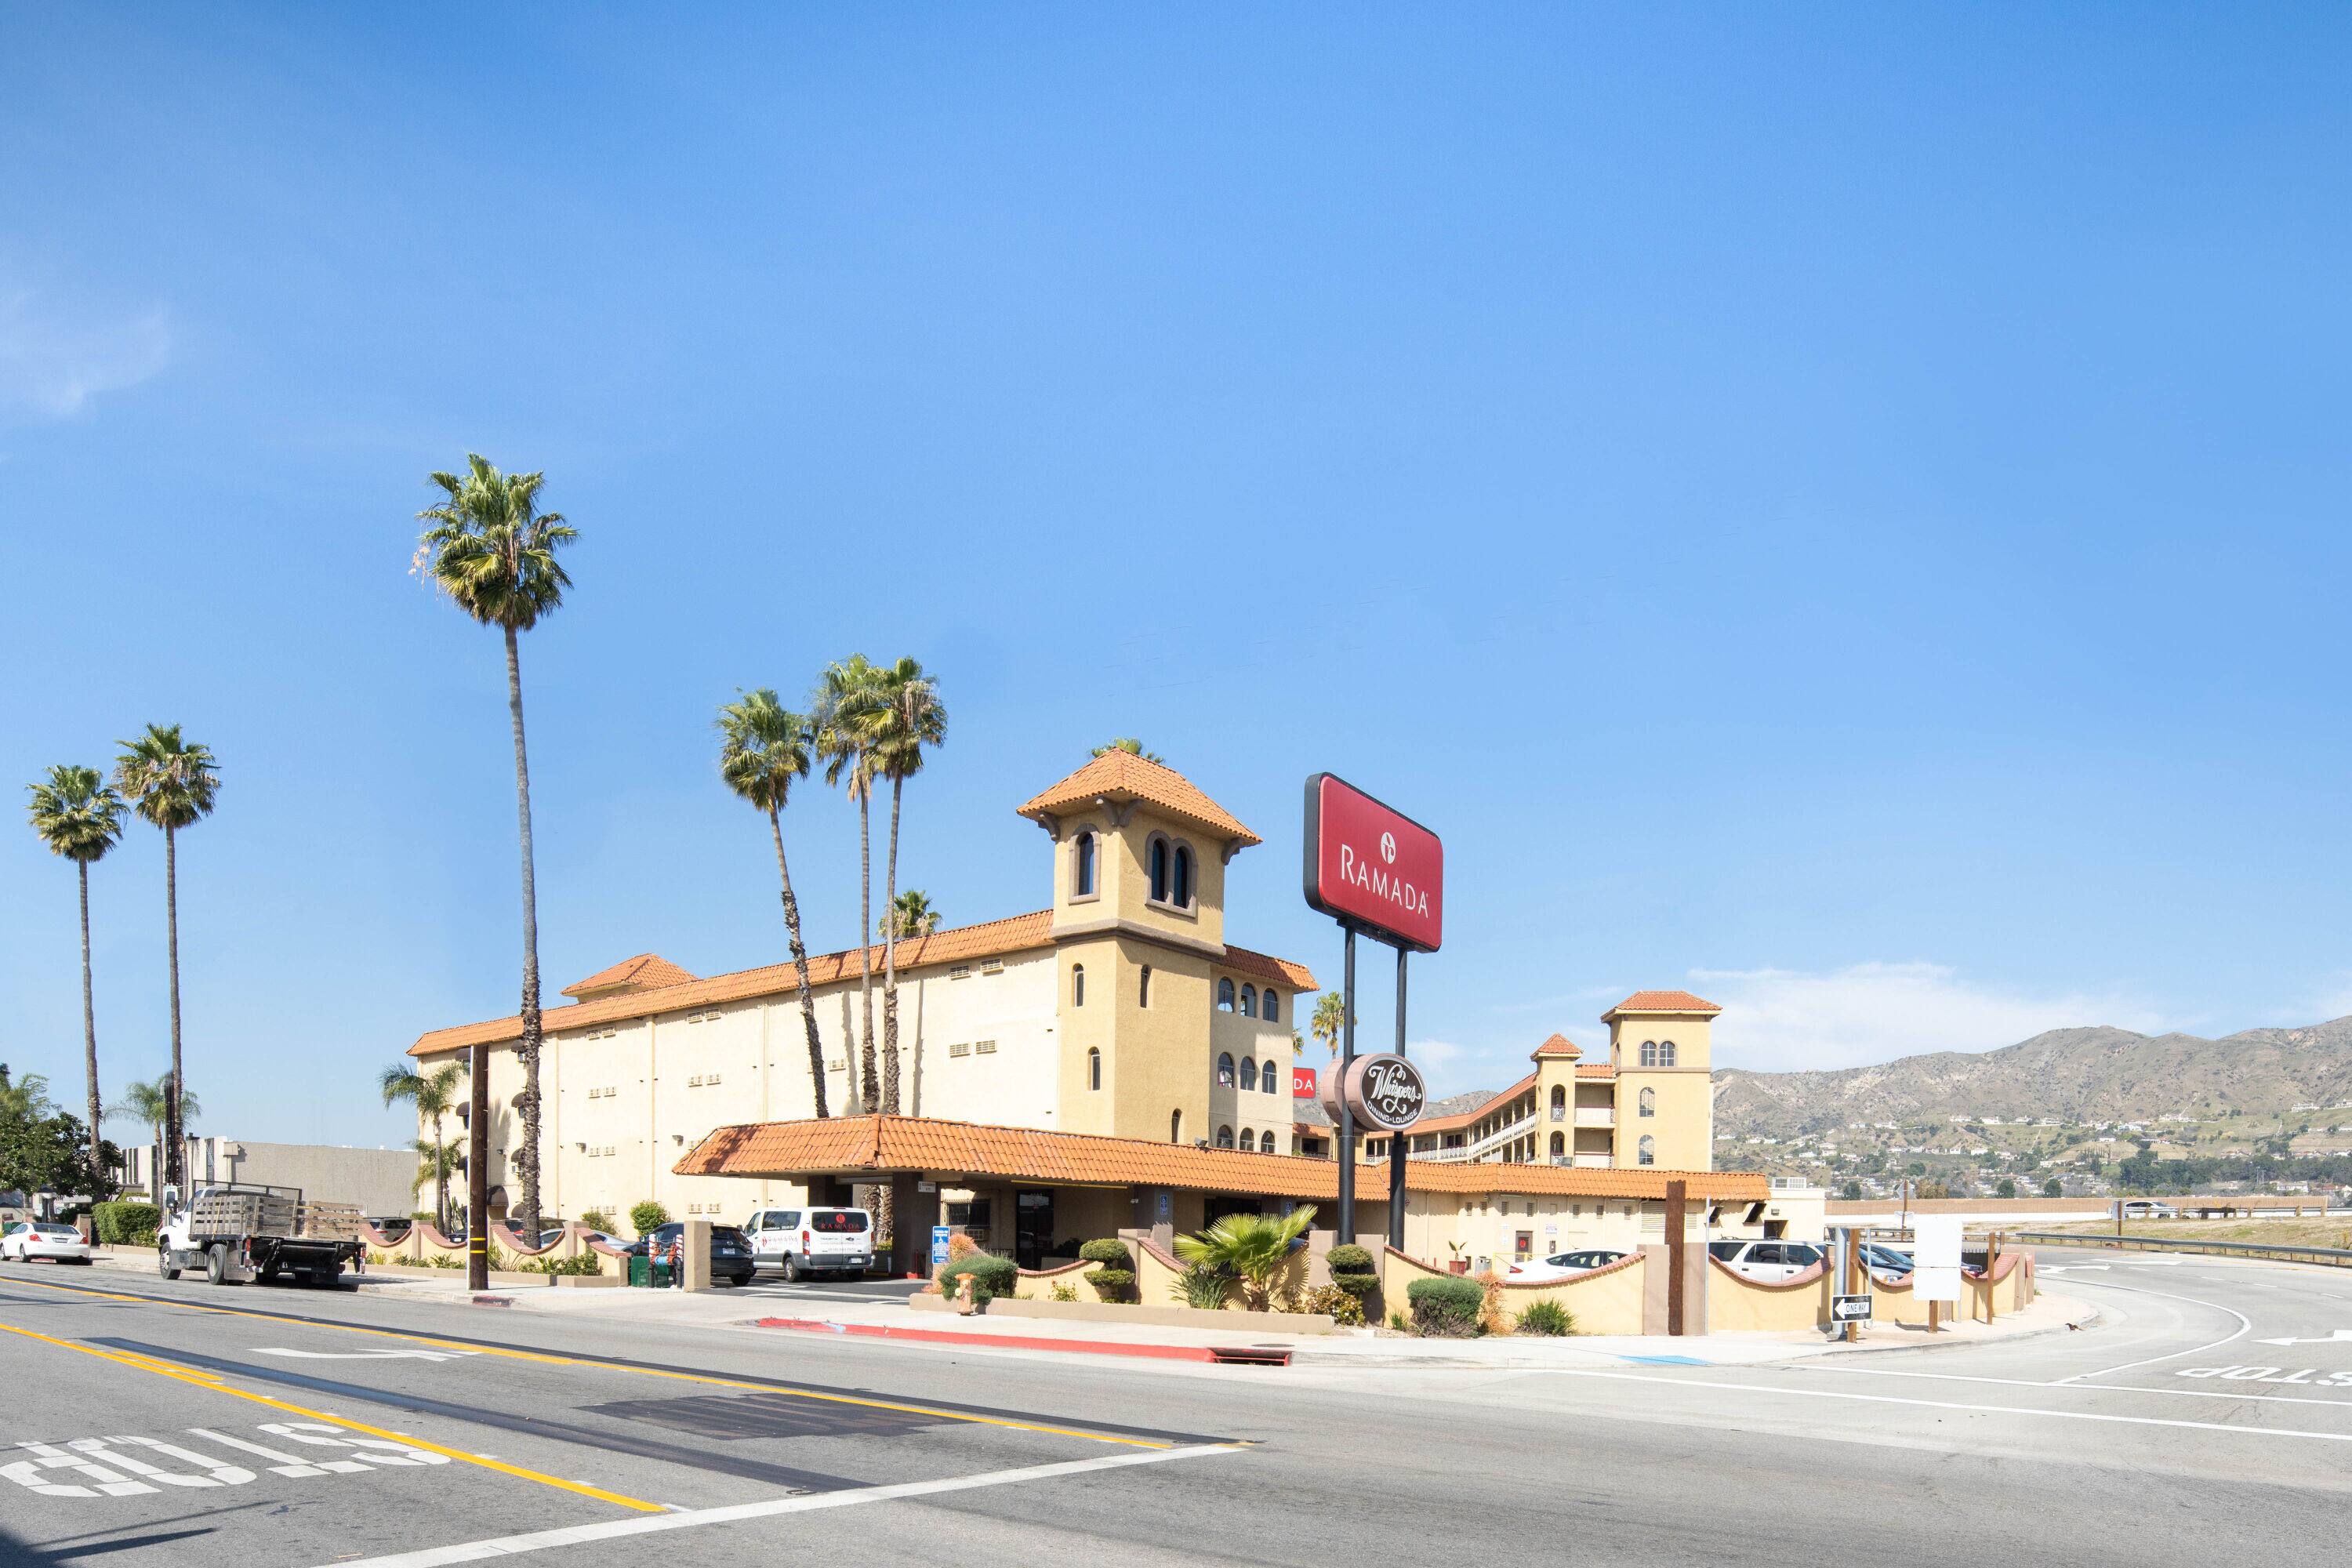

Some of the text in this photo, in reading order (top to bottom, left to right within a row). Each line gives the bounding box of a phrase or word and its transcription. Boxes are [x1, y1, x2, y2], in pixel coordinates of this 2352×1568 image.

[1341, 843, 1428, 919] RAMADA
[1368, 1064, 1421, 1114] Whispers
[1846, 1303, 1867, 1313] ONE WAY
[2175, 1365, 2352, 1386] STOP
[0, 1423, 452, 1497] STOP
